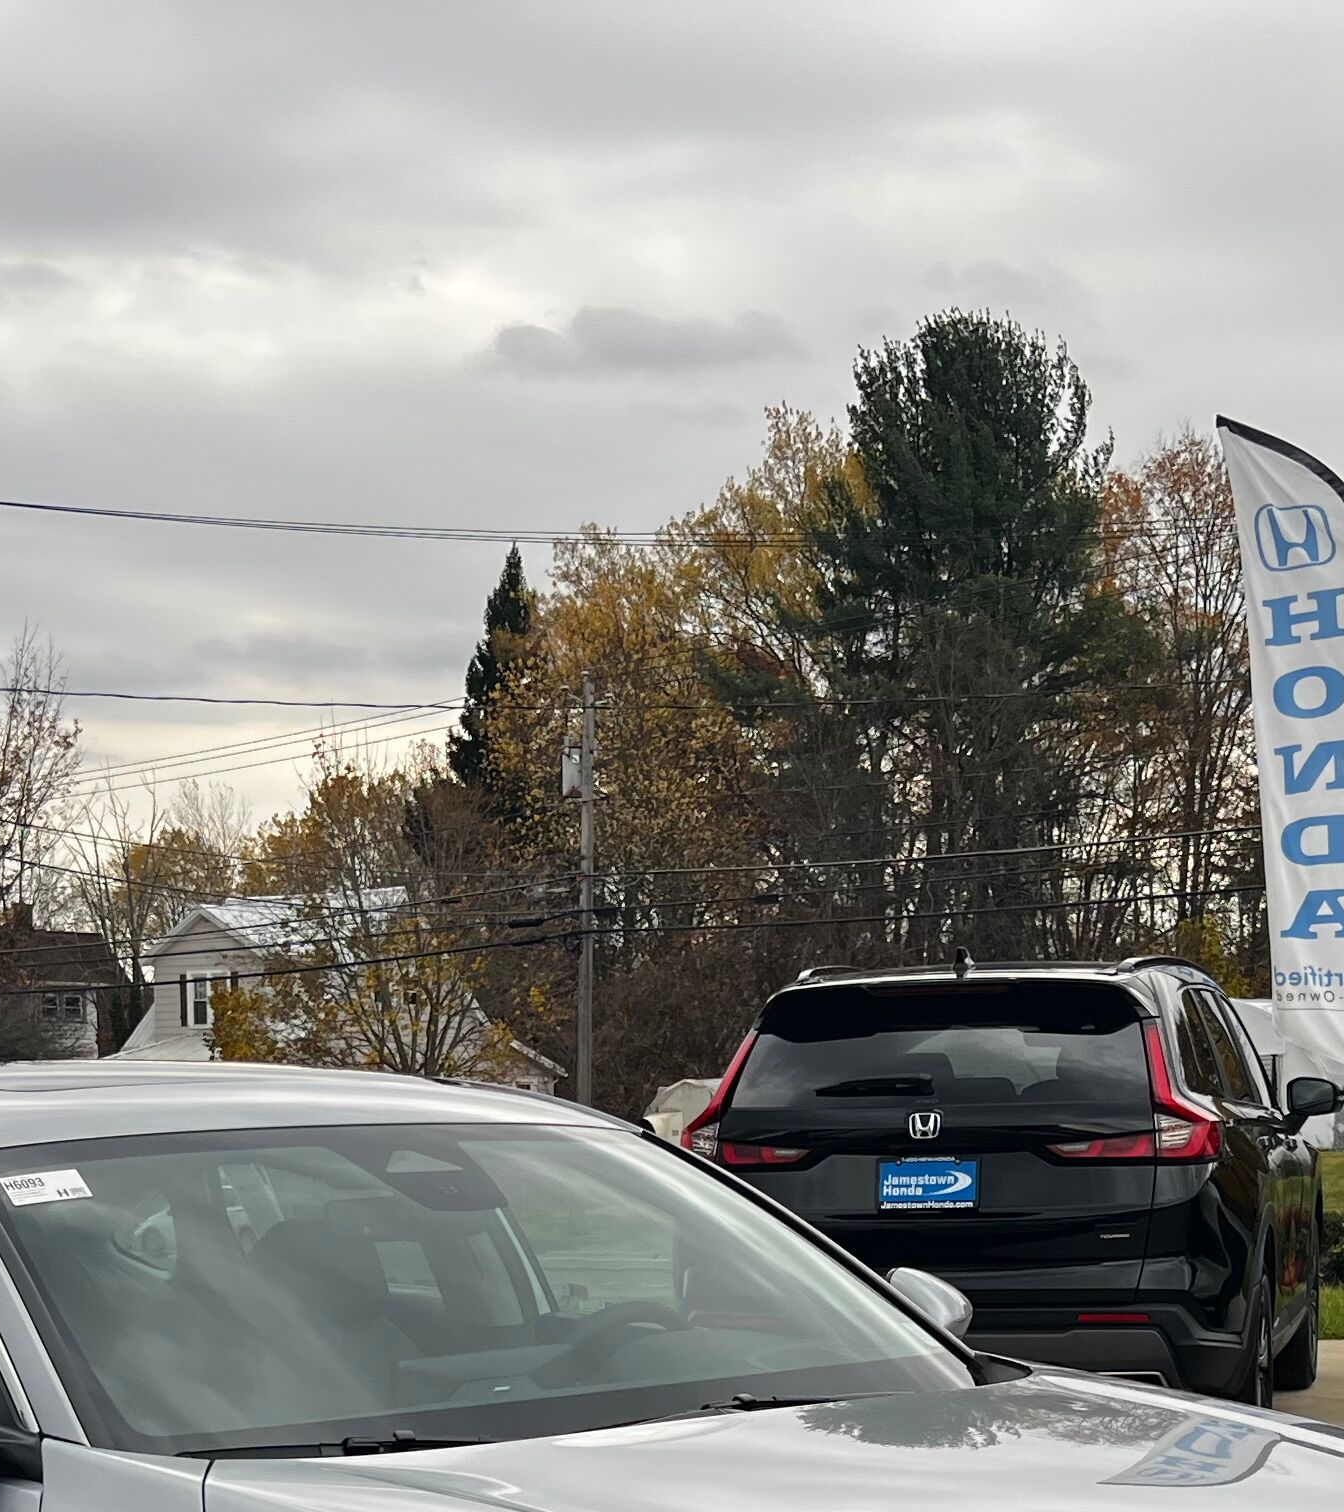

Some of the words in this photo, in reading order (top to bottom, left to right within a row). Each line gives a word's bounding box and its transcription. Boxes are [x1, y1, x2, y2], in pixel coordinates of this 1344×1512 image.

[3, 1177, 45, 1191] H6093
[883, 1174, 955, 1185] Jamestown
[883, 1185, 923, 1196] Honda
